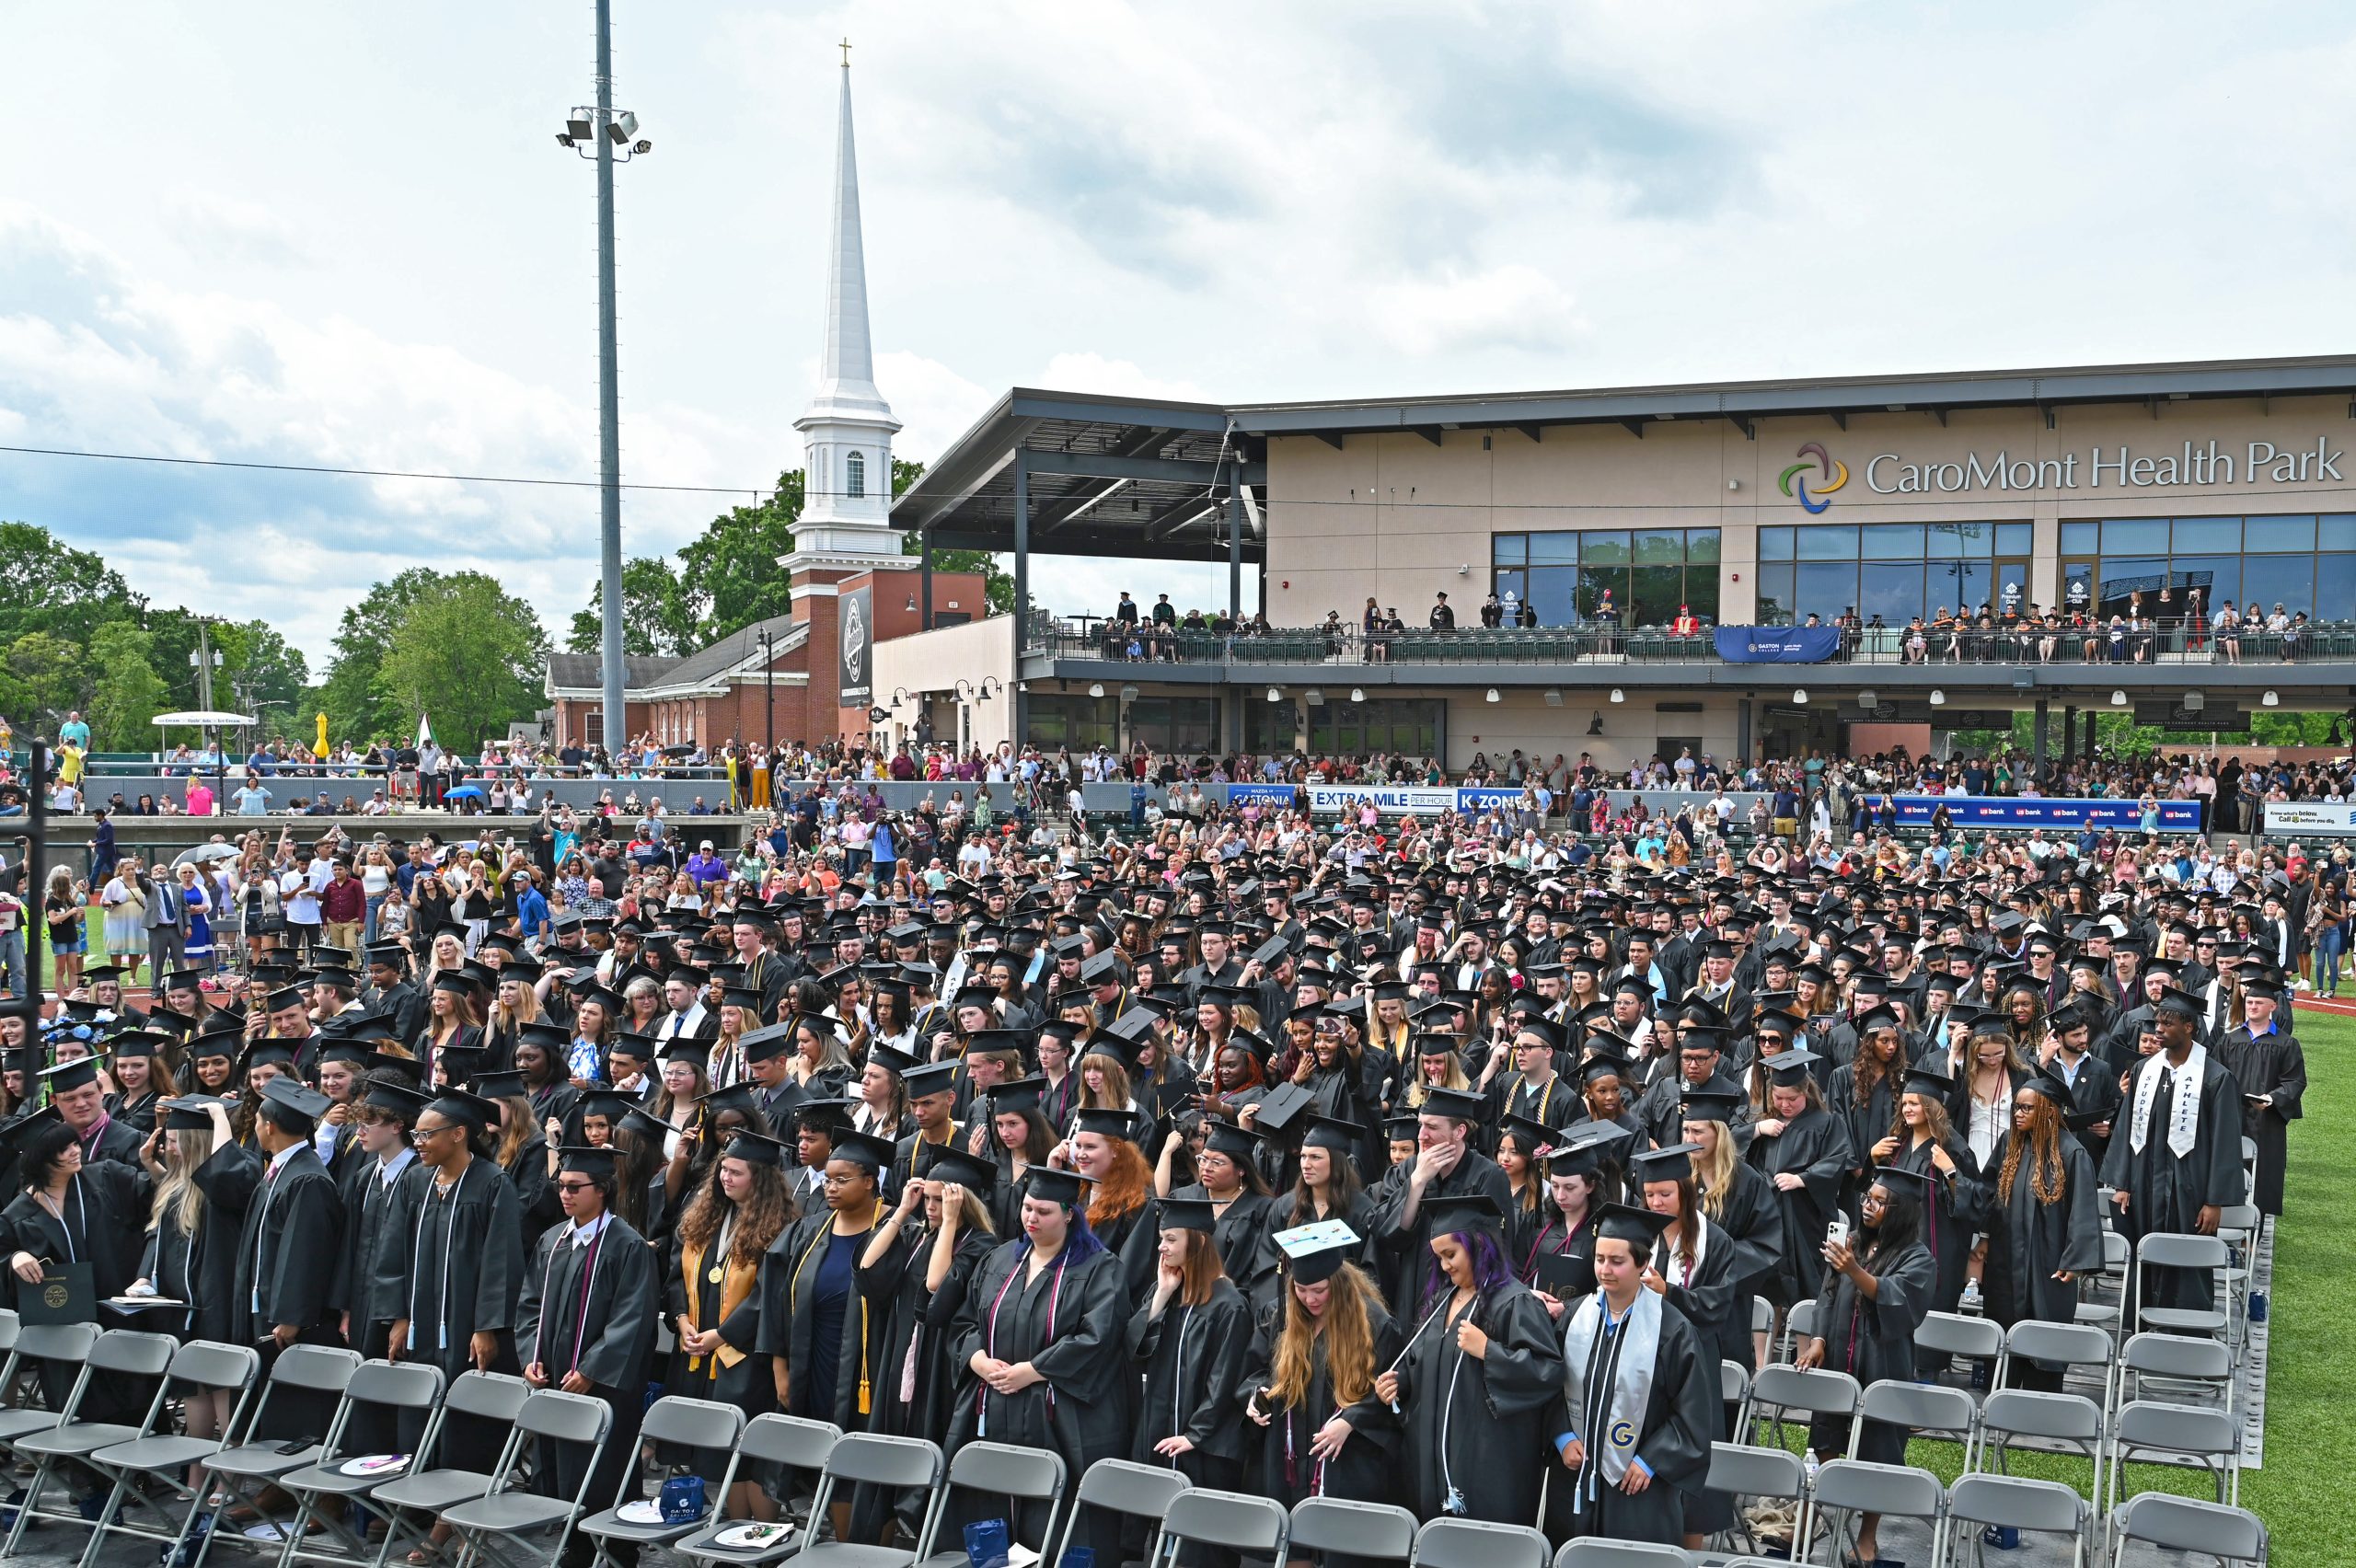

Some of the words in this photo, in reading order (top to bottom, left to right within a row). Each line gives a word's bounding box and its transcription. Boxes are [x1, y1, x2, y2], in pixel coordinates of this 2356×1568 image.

[1866, 450, 2079, 494] CaroMont
[2091, 440, 2234, 488] Health
[2246, 435, 2344, 483] Park
[1316, 792, 1366, 806] EXTRA
[1374, 793, 1408, 806] MILE
[1411, 796, 1426, 804] PER
[1427, 797, 1452, 805] HOUR
[2138, 1076, 2152, 1130] STUDENT
[2179, 1076, 2193, 1132] ATHLETE
[1610, 1421, 1636, 1448] G
